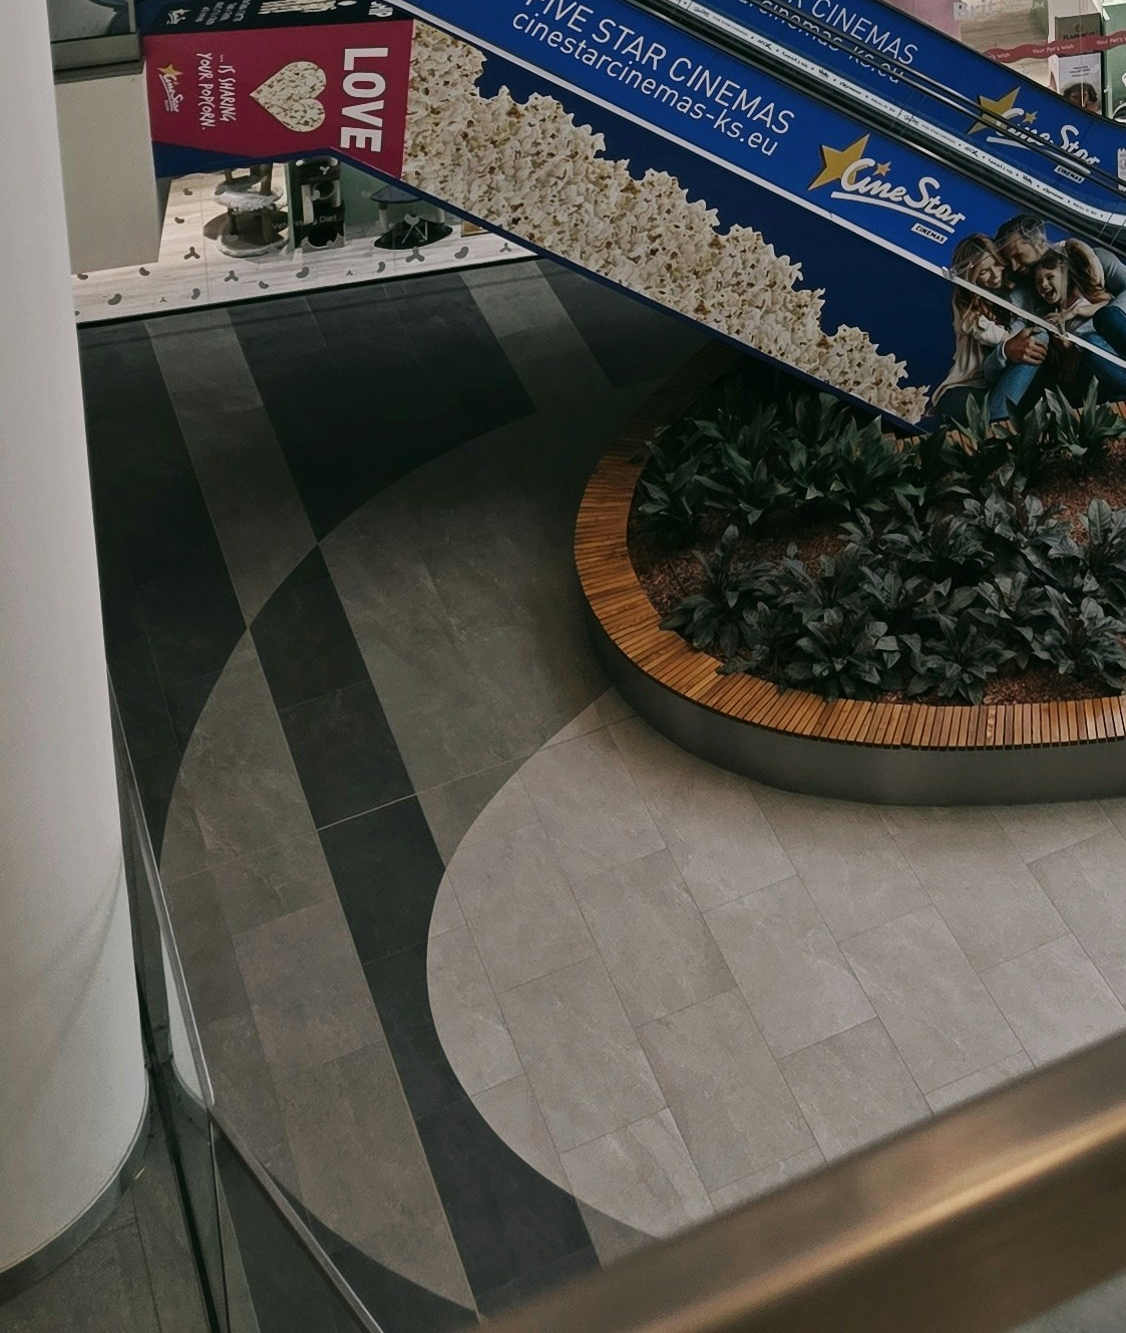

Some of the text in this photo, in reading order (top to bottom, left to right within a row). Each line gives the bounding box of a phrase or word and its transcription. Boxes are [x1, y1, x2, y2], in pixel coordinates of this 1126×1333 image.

[196, 52, 213, 81] YOUR
[220, 64, 236, 74] IS
[512, 11, 778, 157] cinestarcinemas-ks.eu
[592, 19, 667, 71] STAR
[669, 57, 795, 135] CINEMAS
[219, 75, 237, 122] SHARING
[340, 47, 389, 153] LOVE
[840, 157, 966, 226] CineStar
[914, 224, 947, 244] CINEMAS
